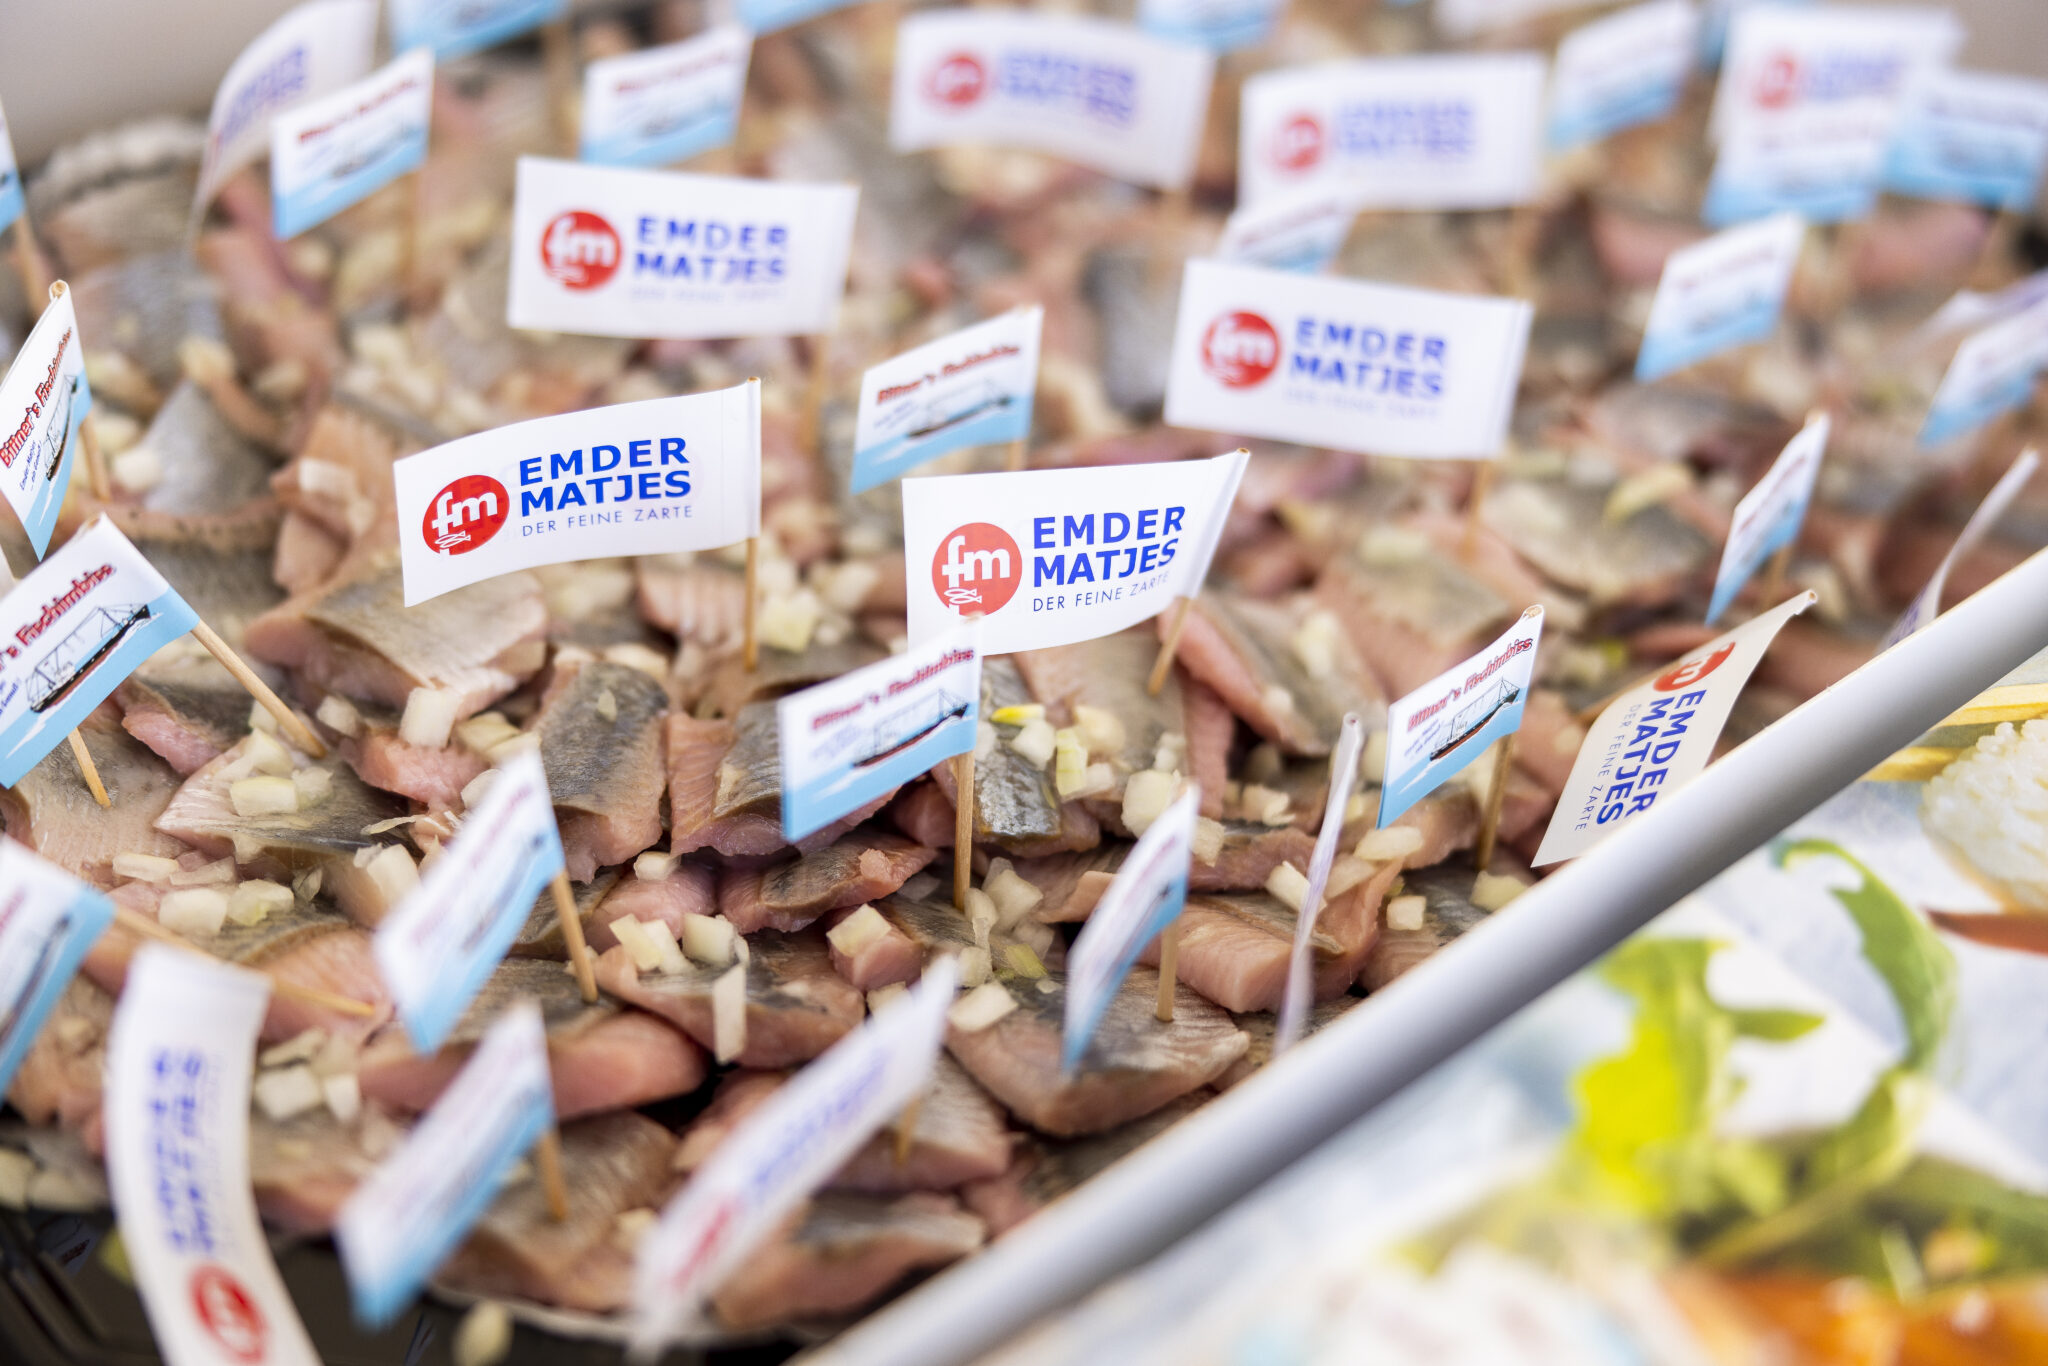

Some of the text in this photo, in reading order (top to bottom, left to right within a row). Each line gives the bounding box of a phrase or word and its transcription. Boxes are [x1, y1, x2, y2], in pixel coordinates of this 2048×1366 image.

[638, 215, 788, 252] EMDER
[634, 252, 786, 285] MATJES
[1297, 318, 1446, 365] EMDER
[1291, 354, 1443, 396] MATJES
[519, 437, 690, 486] EMDER
[521, 470, 692, 517] MATJES
[522, 505, 693, 537] DER FEINE ZARTE
[1033, 506, 1186, 549] EMDER
[1033, 538, 1180, 587] MATJES
[1034, 573, 1170, 612] DER FEINE ZARTE
[1574, 703, 1642, 832] DER FEINE ZARTE
[1596, 696, 1675, 825] MATJES
[1625, 689, 1707, 817] EMDER
